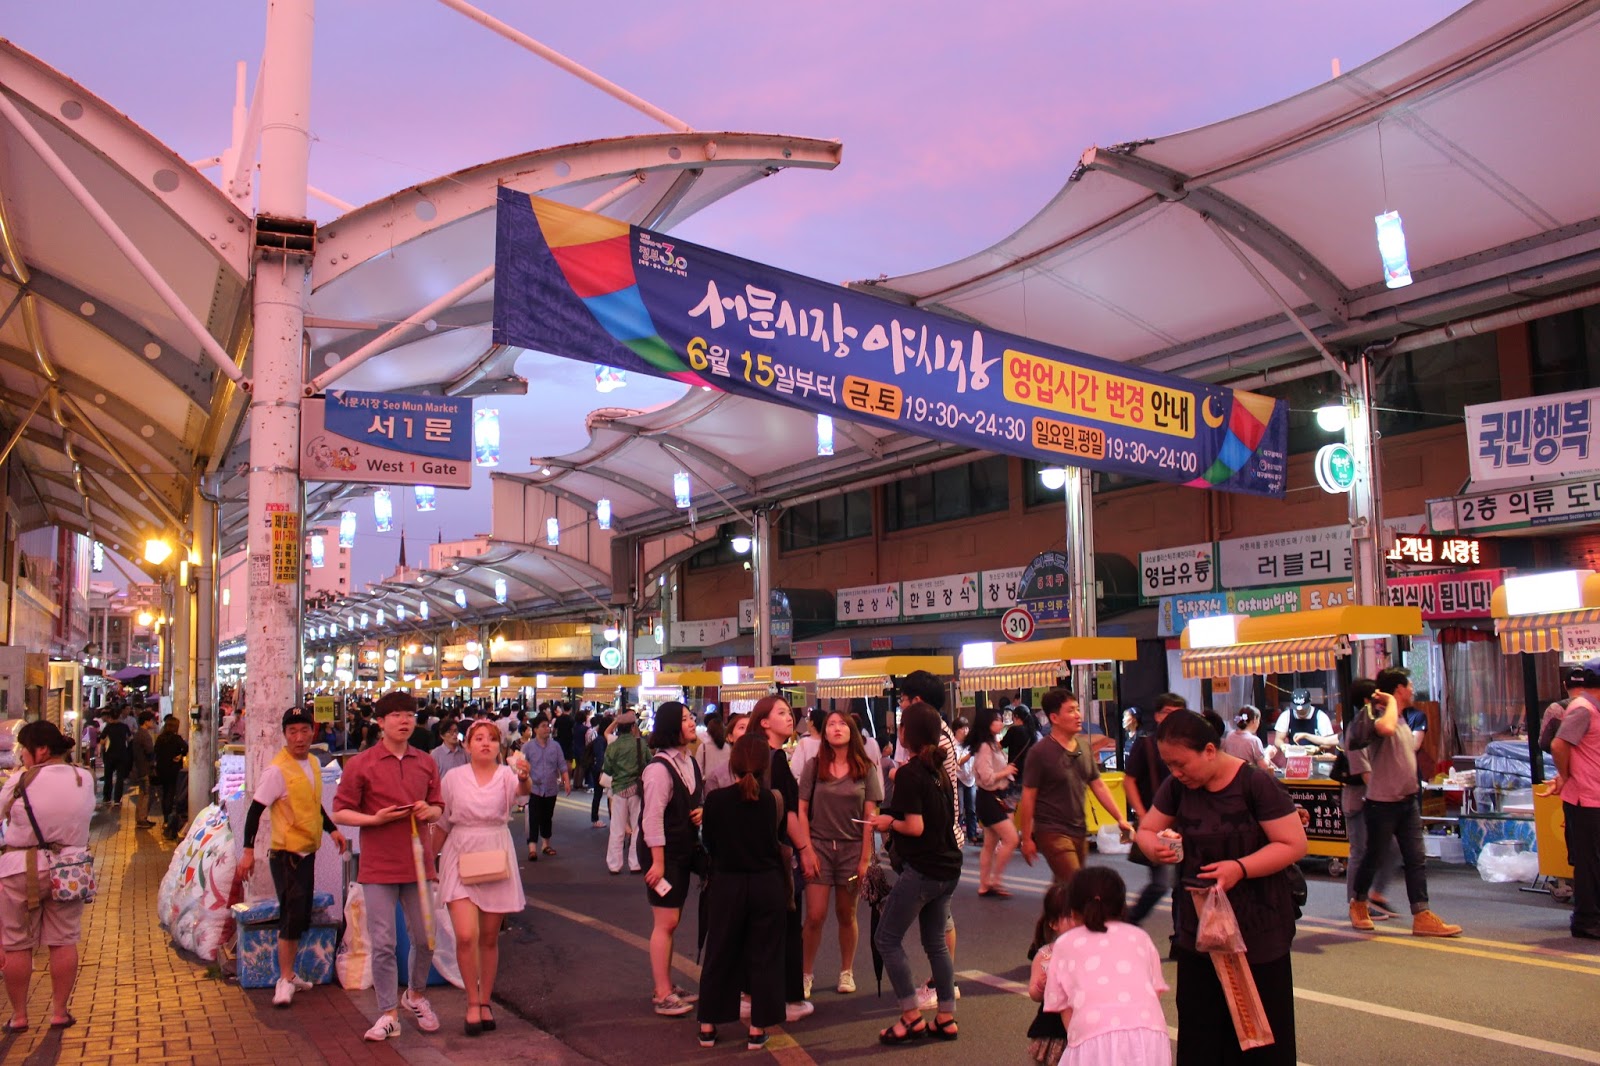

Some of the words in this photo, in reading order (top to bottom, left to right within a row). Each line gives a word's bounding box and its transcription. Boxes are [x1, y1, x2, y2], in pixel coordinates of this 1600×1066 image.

[688, 279, 858, 358] 서문시장
[863, 319, 1001, 393] 야시장
[383, 400, 400, 410] Seo
[402, 401, 423, 411] Mun
[425, 402, 458, 413] Market
[686, 336, 731, 378] 6월
[741, 350, 836, 404] 15일부터
[905, 397, 1026, 442] 19:30~24:30
[1107, 437, 1197, 473] 19:30~24:00
[1010, 357, 1099, 413] 영업시간
[1106, 378, 1145, 423] 변경
[1151, 390, 1189, 433] 안내
[1479, 399, 1591, 468] 국민행복
[366, 460, 404, 473] West
[409, 461, 416, 473] 1
[422, 462, 457, 475] Gate
[1462, 496, 1498, 521] 2층
[1509, 490, 1555, 515] 의류
[1145, 560, 1210, 589] 영남유통
[1258, 549, 1331, 578] 러블리
[910, 587, 970, 609] 한일장식
[1237, 590, 1298, 613] 야채비빔밥
[1440, 581, 1492, 612] 됩니다!
[1009, 617, 1027, 633] 30
